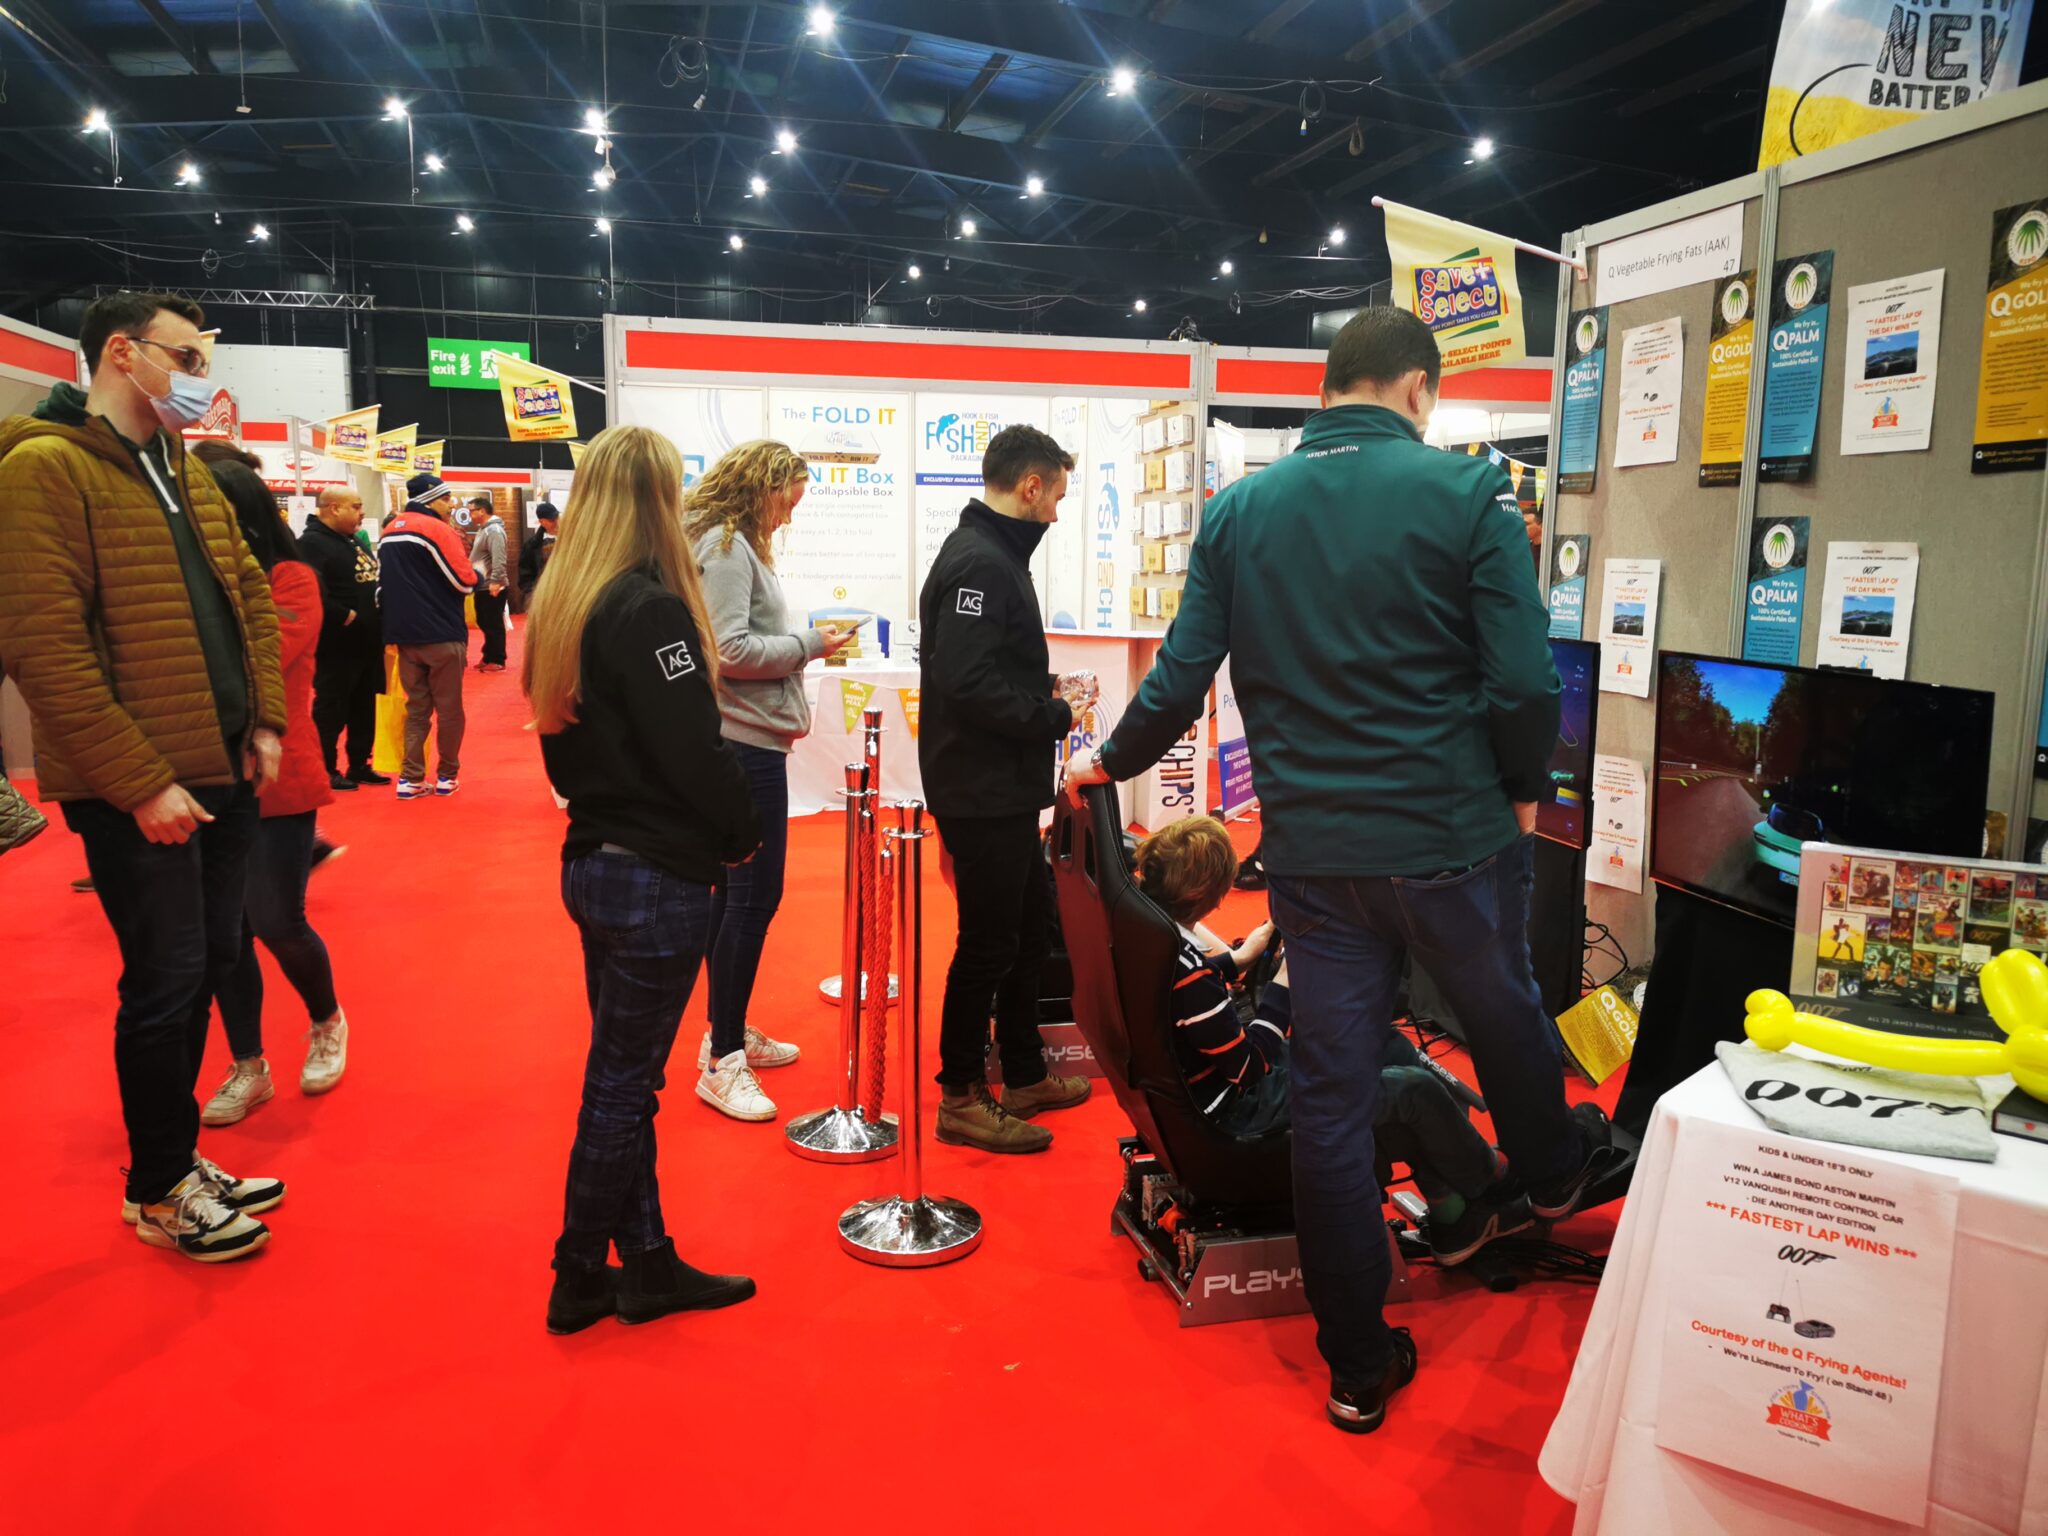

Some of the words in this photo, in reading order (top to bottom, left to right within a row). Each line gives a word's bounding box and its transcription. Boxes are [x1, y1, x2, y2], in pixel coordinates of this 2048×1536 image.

[1608, 266, 1614, 278] Q
[1616, 257, 1656, 276] Vegetable
[1658, 250, 1683, 266] Frying
[1685, 246, 1702, 258] Fats
[1704, 235, 1730, 256] (AAK)
[1723, 259, 1735, 272] 47
[1420, 284, 1498, 324] Select
[1990, 290, 2048, 318] QGOL
[430, 350, 456, 362] Fire
[1441, 356, 1477, 368] AILABLE
[432, 364, 456, 376] exit
[782, 408, 806, 420] The
[812, 406, 870, 424] FOLD
[879, 408, 896, 424] IT
[1306, 450, 1328, 459] ASTON
[1330, 444, 1359, 456] MARTIN
[831, 467, 848, 483] IT
[856, 467, 894, 484] Box
[810, 486, 869, 498] Collapsible
[873, 487, 894, 497] Box
[926, 525, 941, 534] for
[962, 596, 982, 610] AG
[669, 652, 692, 664] AG
[1600, 990, 1637, 1046] QGOL
[1745, 1080, 1925, 1118] 007
[1758, 1145, 1781, 1156] KIDS
[1782, 1151, 1789, 1159] &
[1791, 1152, 1824, 1168] UNDER
[1848, 1166, 1874, 1178] ONLY
[1733, 1162, 1751, 1174] WIN
[1752, 1167, 1760, 1175] A
[1761, 1169, 1792, 1183] JAMES
[1794, 1177, 1821, 1190] BOND
[1823, 1184, 1857, 1199] ASTON
[1858, 1192, 1896, 1209] MARTIN
[1723, 1175, 1740, 1185] V12
[1743, 1179, 1790, 1196] VANQUISH
[1792, 1191, 1831, 1207] REMOTE
[1833, 1200, 1880, 1219] CONTROL
[1882, 1212, 1904, 1225] CAR
[1751, 1195, 1767, 1206] DIE
[1769, 1199, 1814, 1218] ANOTHER
[1816, 1211, 1836, 1221] DAY
[1836, 1216, 1876, 1233] EDITION
[1730, 1207, 1804, 1234] FASTEST
[1807, 1224, 1840, 1243] LAP
[1844, 1234, 1890, 1257] WINS
[1778, 1244, 1836, 1266] 007
[1692, 1320, 1749, 1346] Courtesy
[1752, 1339, 1766, 1348] of
[1768, 1342, 1794, 1356] the
[1792, 1348, 1803, 1360] Q
[1806, 1352, 1849, 1374] Frying
[1852, 1365, 1907, 1390] Agents!
[1724, 1347, 1749, 1360] We're
[1751, 1356, 1791, 1373] Licensed
[1794, 1367, 1804, 1376] To
[1806, 1371, 1824, 1382] Fry!
[1832, 1379, 1844, 1388] on
[1846, 1381, 1873, 1396] Stand
